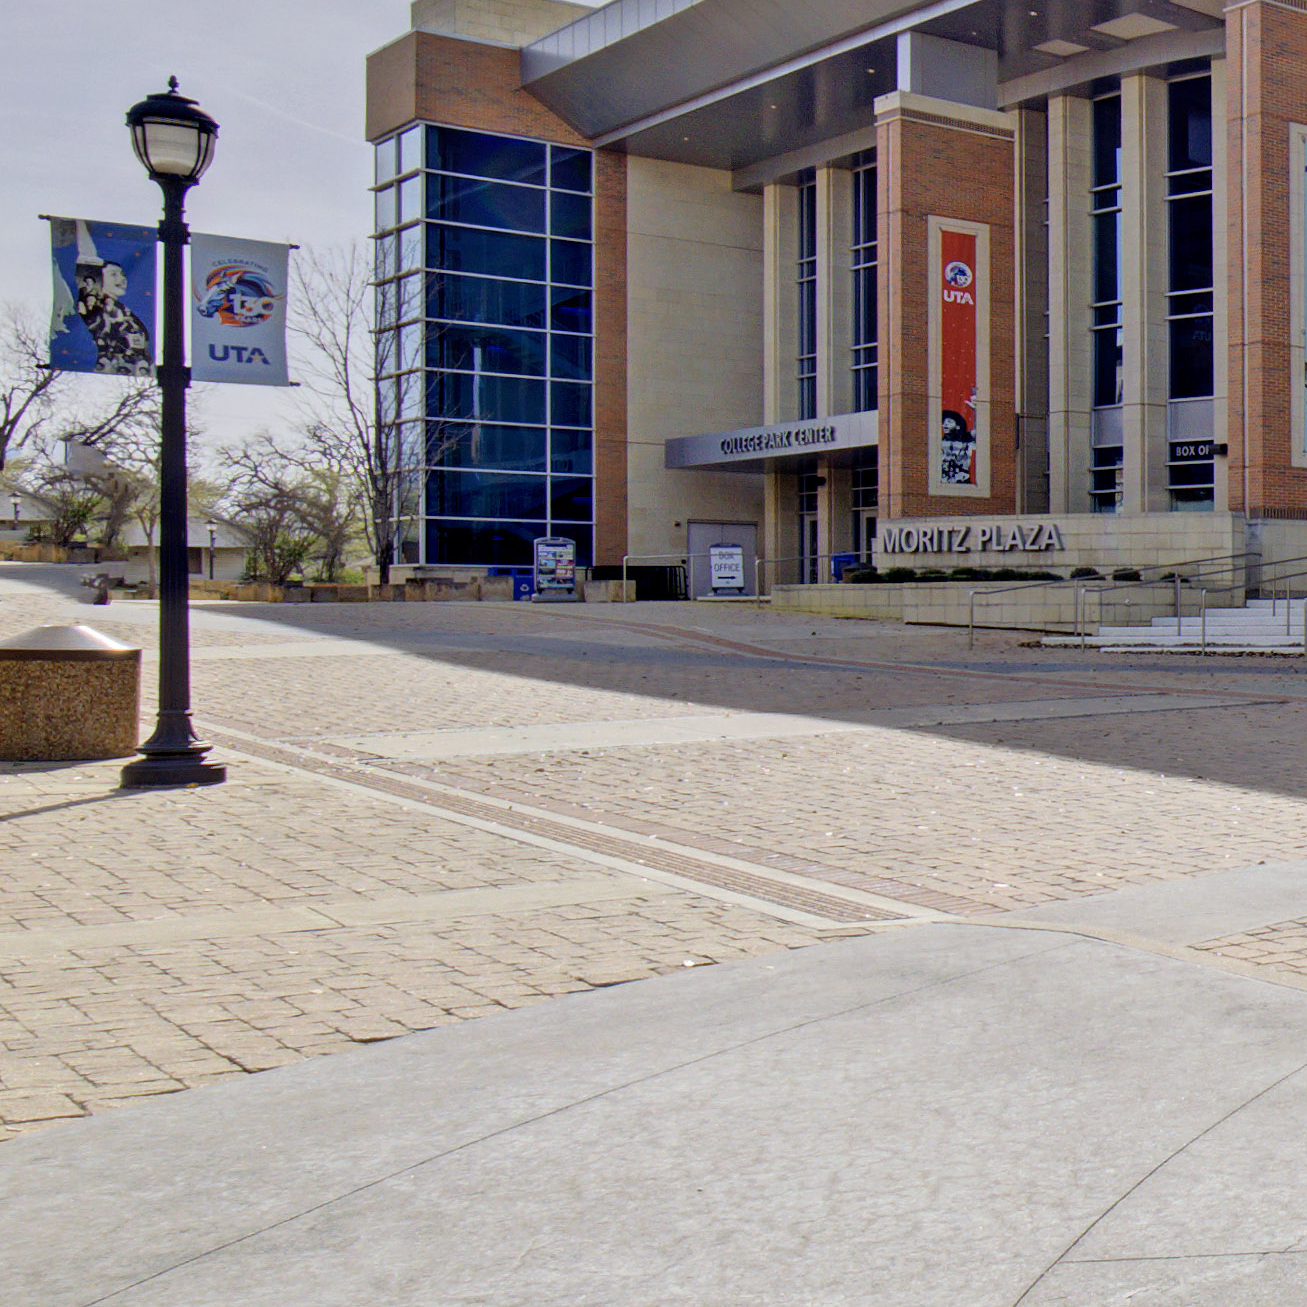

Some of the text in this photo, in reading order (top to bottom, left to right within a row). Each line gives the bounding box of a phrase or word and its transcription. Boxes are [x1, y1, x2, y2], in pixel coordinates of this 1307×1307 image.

[943, 289, 974, 305] UTA
[208, 343, 271, 365] UTA
[720, 426, 836, 455] COLLEGE PARK CENTER
[1176, 446, 1196, 456] BOX
[883, 524, 1065, 553] MORITZ PLAZA
[713, 563, 741, 572] OFFICE
